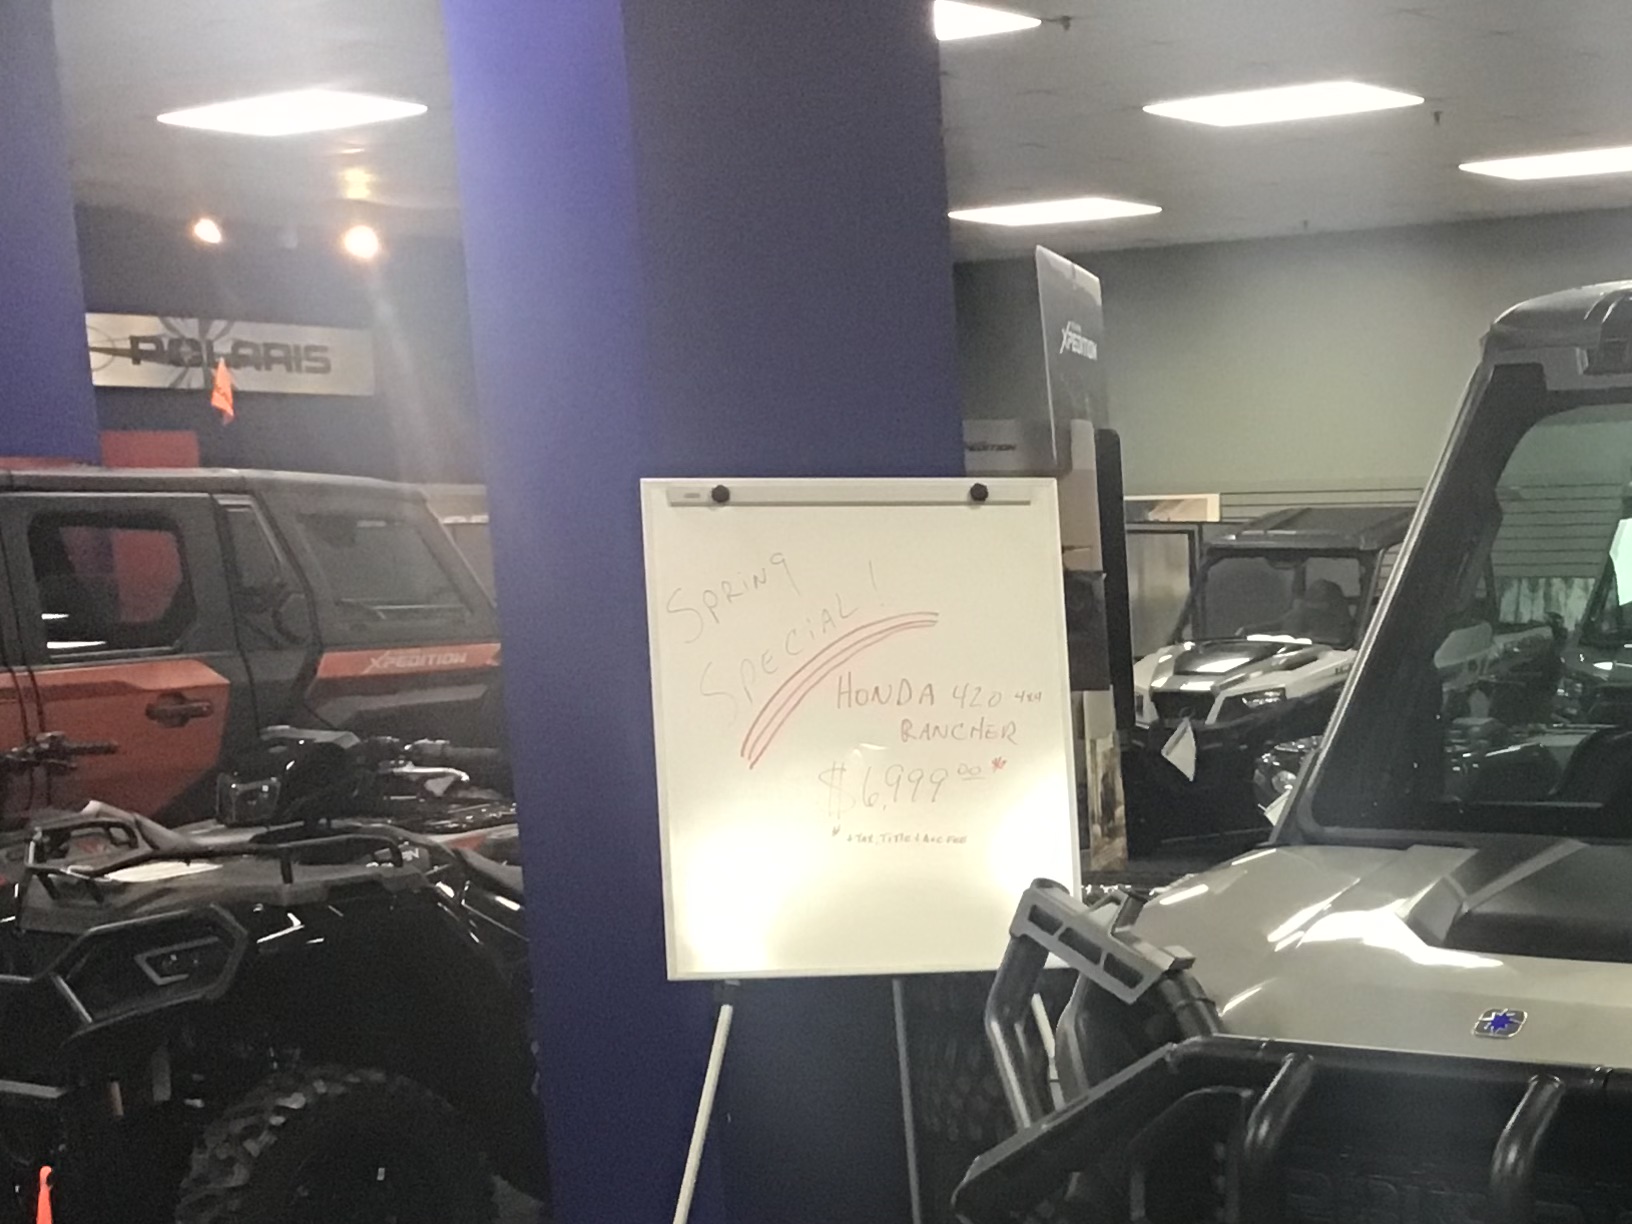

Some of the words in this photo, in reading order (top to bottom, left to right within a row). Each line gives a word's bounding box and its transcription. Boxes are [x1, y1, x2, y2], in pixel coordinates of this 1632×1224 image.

[129, 334, 332, 375] POLARIS
[361, 649, 467, 674] XPEDITION
[837, 672, 935, 709] HONDA
[952, 682, 1002, 709] 420
[900, 716, 1018, 746] RANCHER
